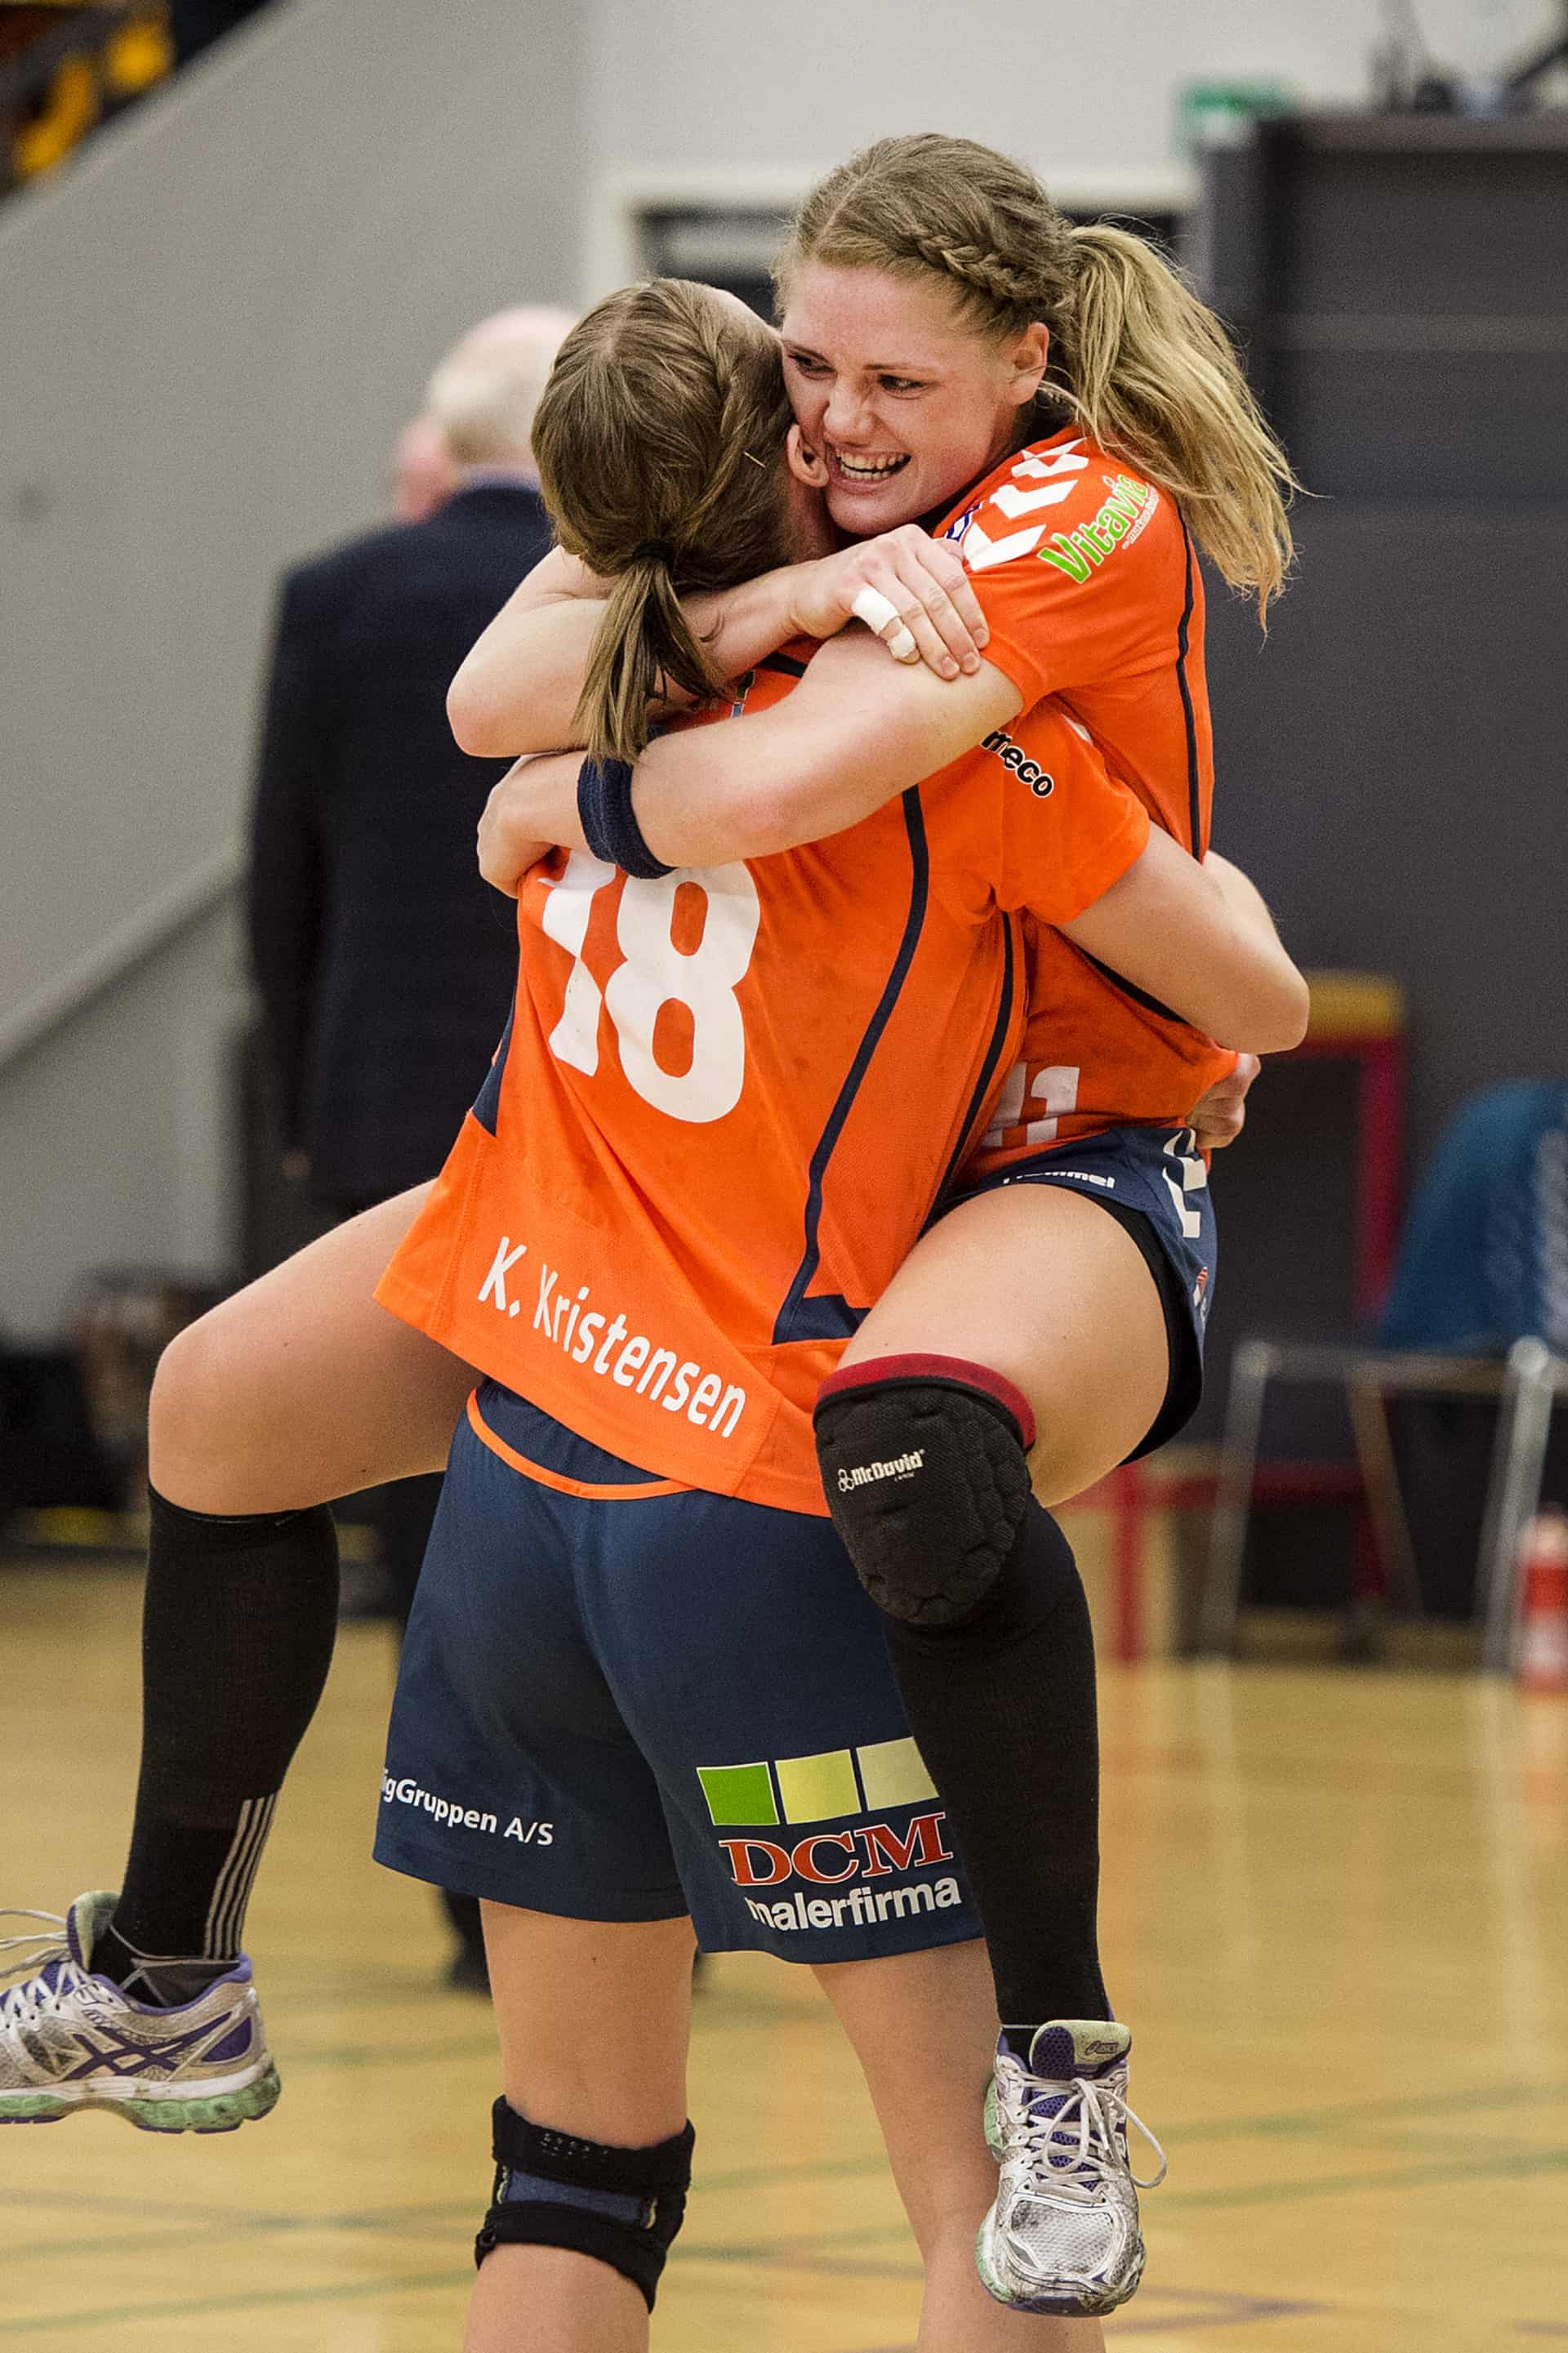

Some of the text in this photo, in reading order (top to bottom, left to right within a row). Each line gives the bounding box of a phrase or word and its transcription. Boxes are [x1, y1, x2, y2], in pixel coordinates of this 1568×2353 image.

[1036, 473, 1148, 585] Vitavia
[537, 849, 761, 1123] 18
[478, 1235, 746, 1438] K. Kristensen
[850, 1450, 924, 1486] McDavid
[503, 1816, 555, 1846] A/S
[718, 1811, 954, 1887] DCM
[744, 1877, 963, 1932] malerfirma
